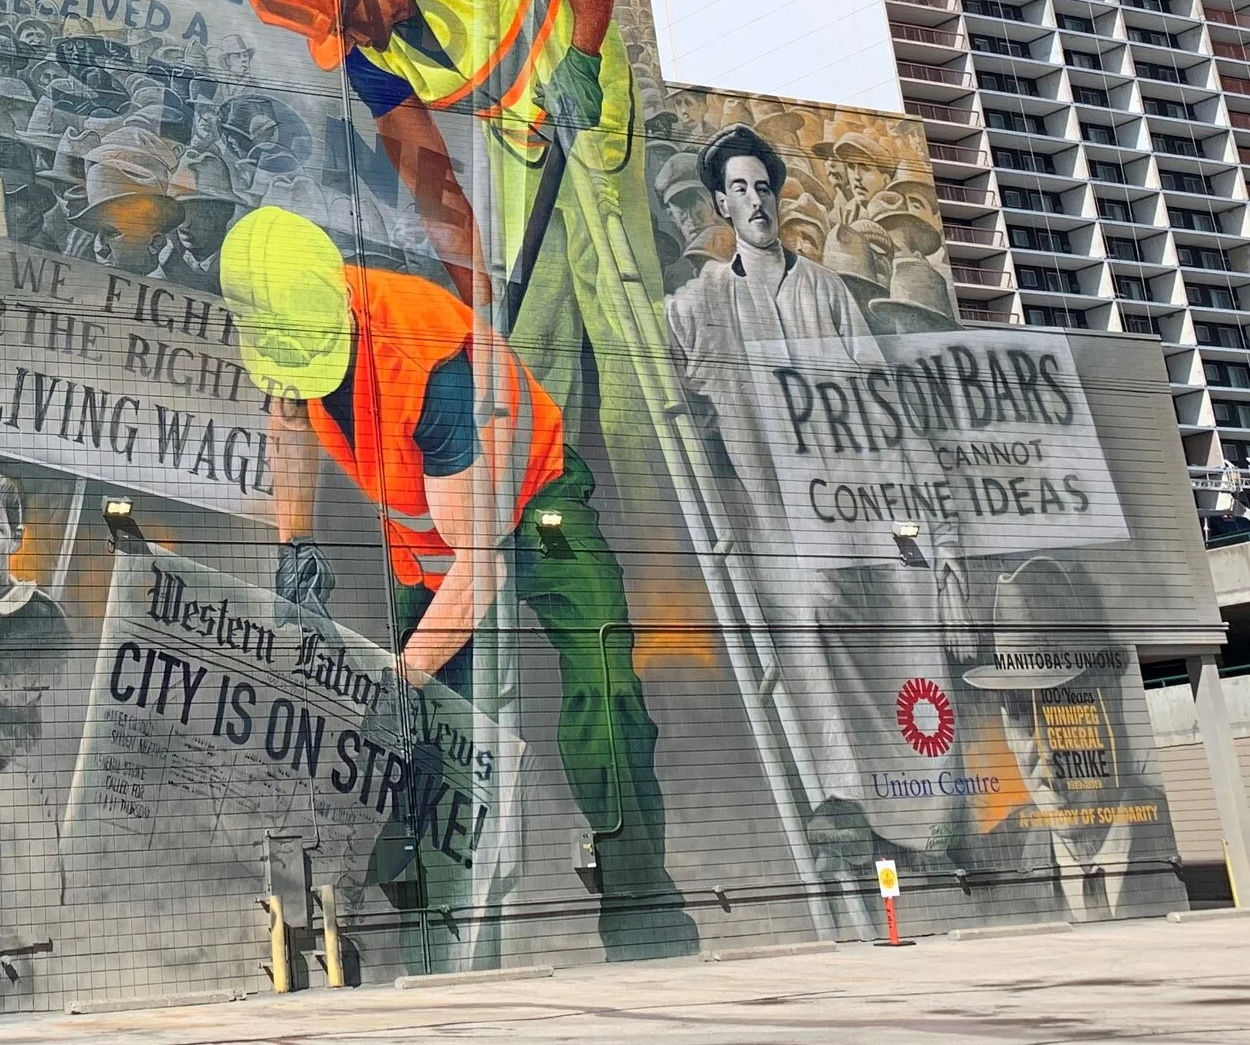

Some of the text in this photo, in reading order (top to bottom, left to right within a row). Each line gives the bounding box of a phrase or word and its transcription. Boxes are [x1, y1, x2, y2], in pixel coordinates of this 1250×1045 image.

[182, 11, 209, 45] A
[8, 250, 242, 347] WE FIGHT
[19, 302, 107, 363] THE
[125, 333, 250, 404] RIGHT
[259, 374, 303, 422] TO
[772, 346, 1075, 455] PRISON BARS
[154, 402, 282, 497] WAGE
[937, 438, 1043, 472] CANNOT
[809, 474, 1089, 523] CONFINE IDEAS
[147, 561, 495, 782] Western Labor News
[994, 652, 1124, 671] MANITOBA'S UNIONS
[110, 641, 208, 726] CITY
[213, 675, 258, 746] IS
[265, 697, 326, 779] ON
[1041, 687, 1095, 704] 100 Years
[1042, 705, 1099, 726] WINNIPEG
[1047, 727, 1104, 750] GENERAL
[1052, 750, 1110, 779] STRIKE
[871, 770, 1000, 798] Union Centre
[1020, 812, 1028, 828] A
[1081, 808, 1096, 825] OF
[1097, 805, 1159, 824] SOLIDARITY
